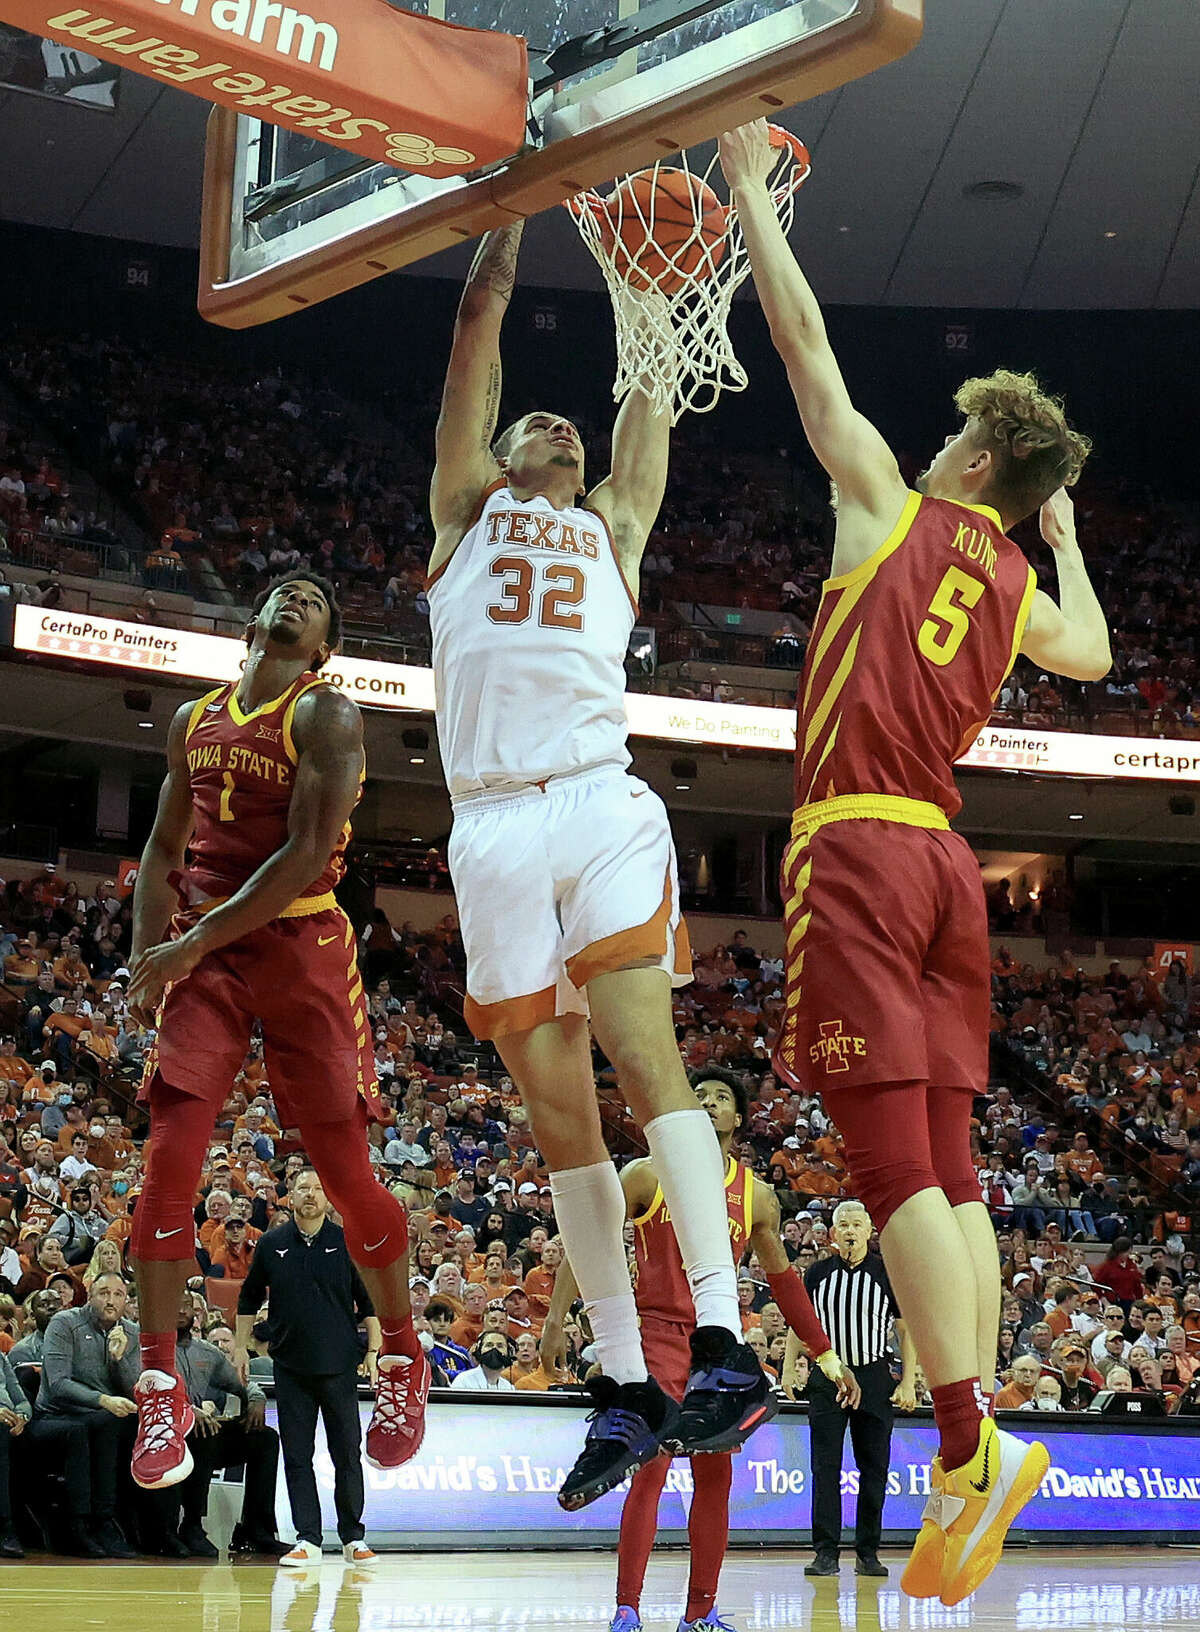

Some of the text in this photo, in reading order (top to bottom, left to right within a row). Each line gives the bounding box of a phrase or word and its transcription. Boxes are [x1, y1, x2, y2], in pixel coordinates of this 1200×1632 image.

[487, 510, 600, 561] TEXAS
[486, 555, 587, 633] 32
[917, 564, 986, 667] 5
[41, 616, 177, 651] CertaPro Painters
[667, 714, 691, 729] We
[695, 717, 716, 732] Do
[720, 720, 780, 741] Painting
[990, 735, 1049, 752] Painters
[227, 746, 290, 785] STATE
[1114, 751, 1200, 772] certapr
[219, 771, 236, 821] 1
[809, 1036, 868, 1064] STATE
[367, 1455, 498, 1492] David's
[747, 1459, 804, 1494] The
[1048, 1466, 1141, 1499] David's
[1138, 1467, 1200, 1499] HEAL
